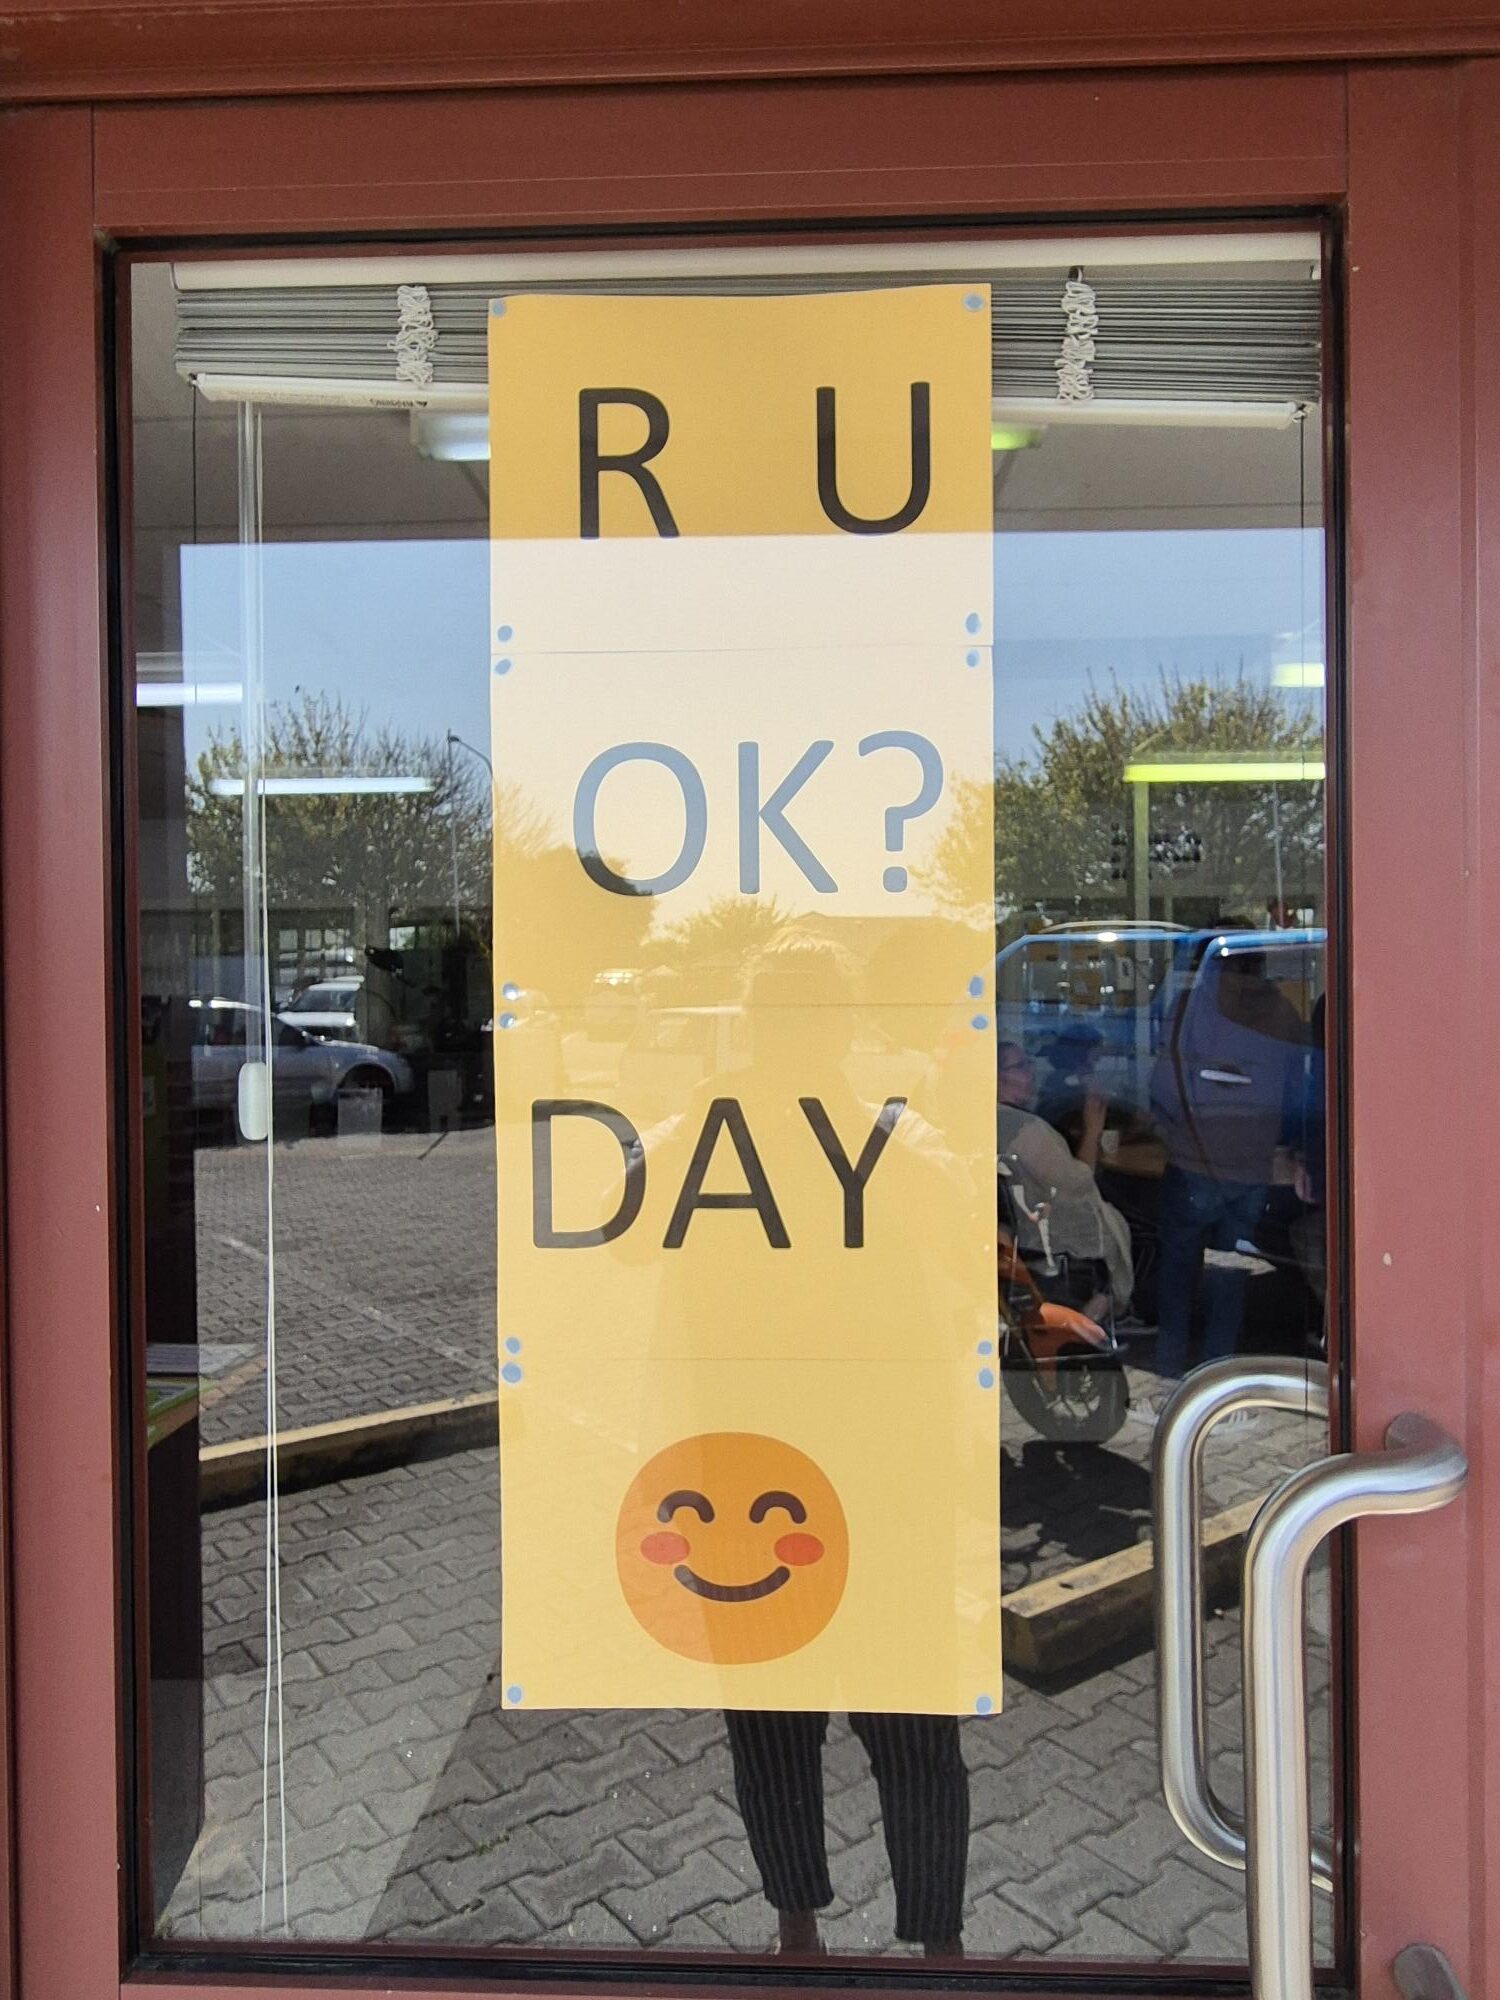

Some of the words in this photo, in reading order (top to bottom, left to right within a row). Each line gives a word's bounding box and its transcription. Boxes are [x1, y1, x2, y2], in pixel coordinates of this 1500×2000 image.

[579, 387, 679, 538] R
[817, 382, 930, 534] U
[573, 730, 944, 897] OK?
[531, 1097, 907, 1249] DAY
